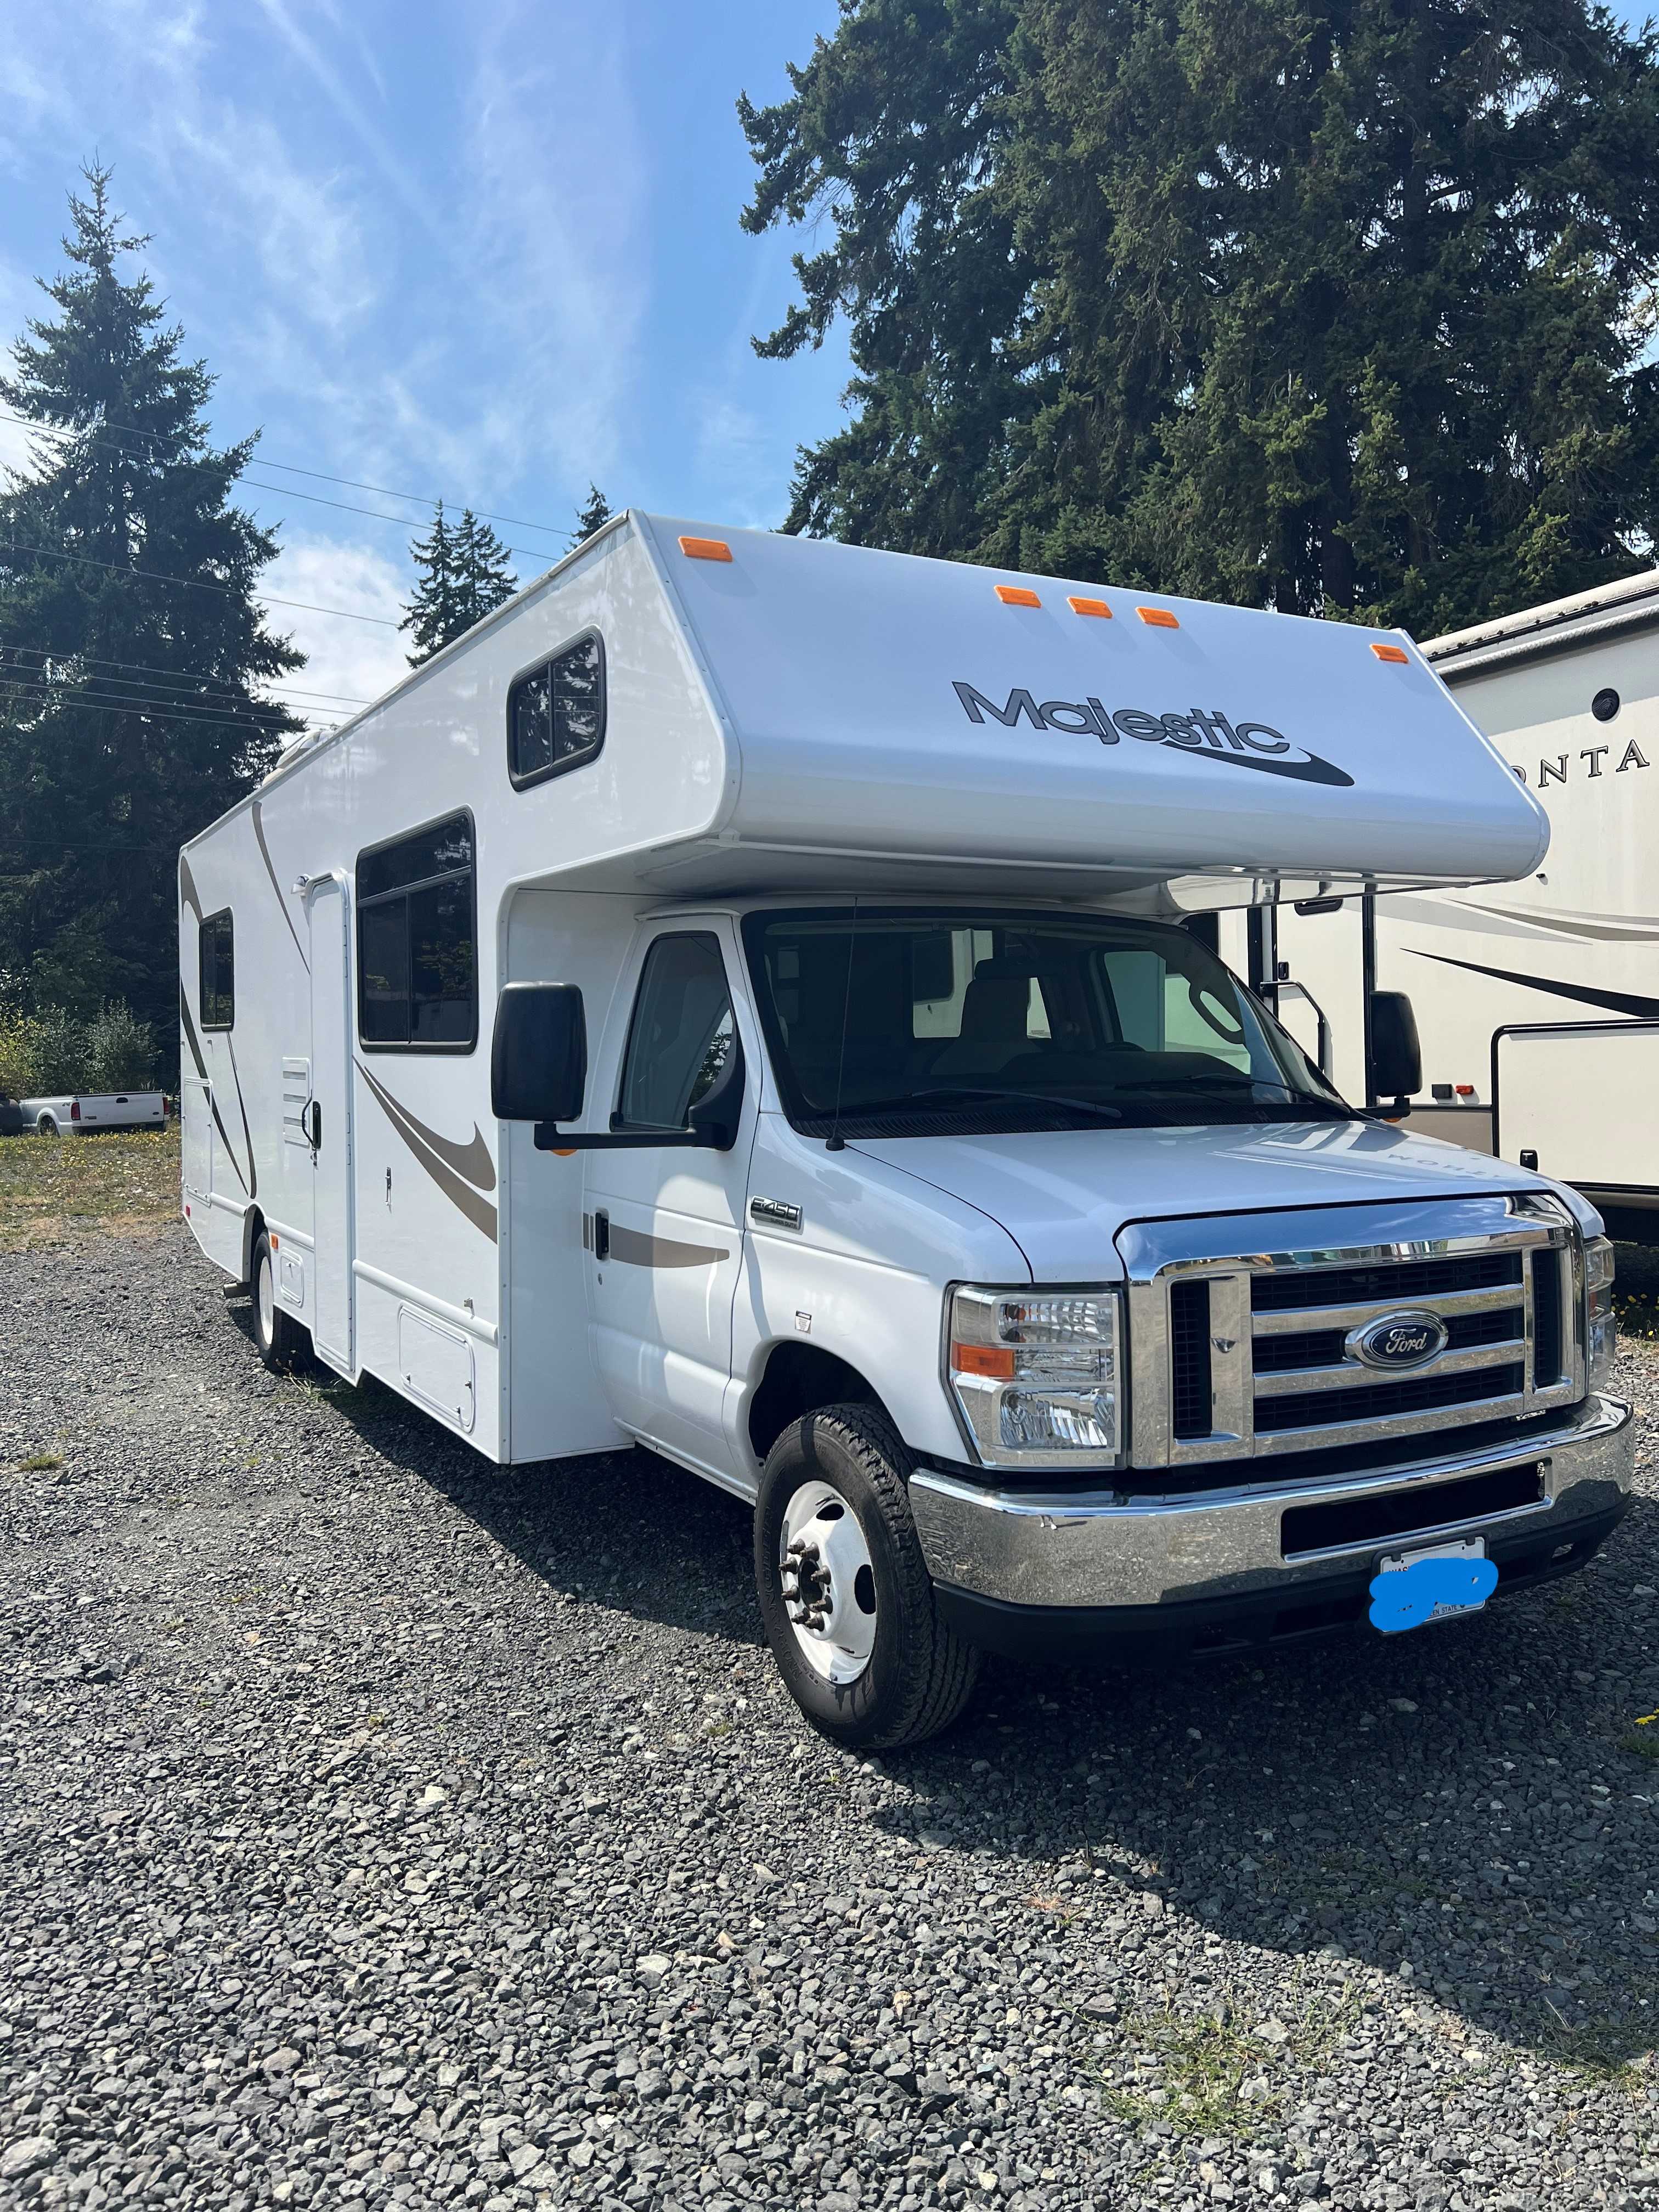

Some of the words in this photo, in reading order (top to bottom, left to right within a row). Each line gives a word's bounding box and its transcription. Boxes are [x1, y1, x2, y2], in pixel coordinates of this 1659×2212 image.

[951, 680, 1290, 754] Majestic
[1385, 1328, 1427, 1354] Ford
[1442, 1604, 1458, 1613] STATE
